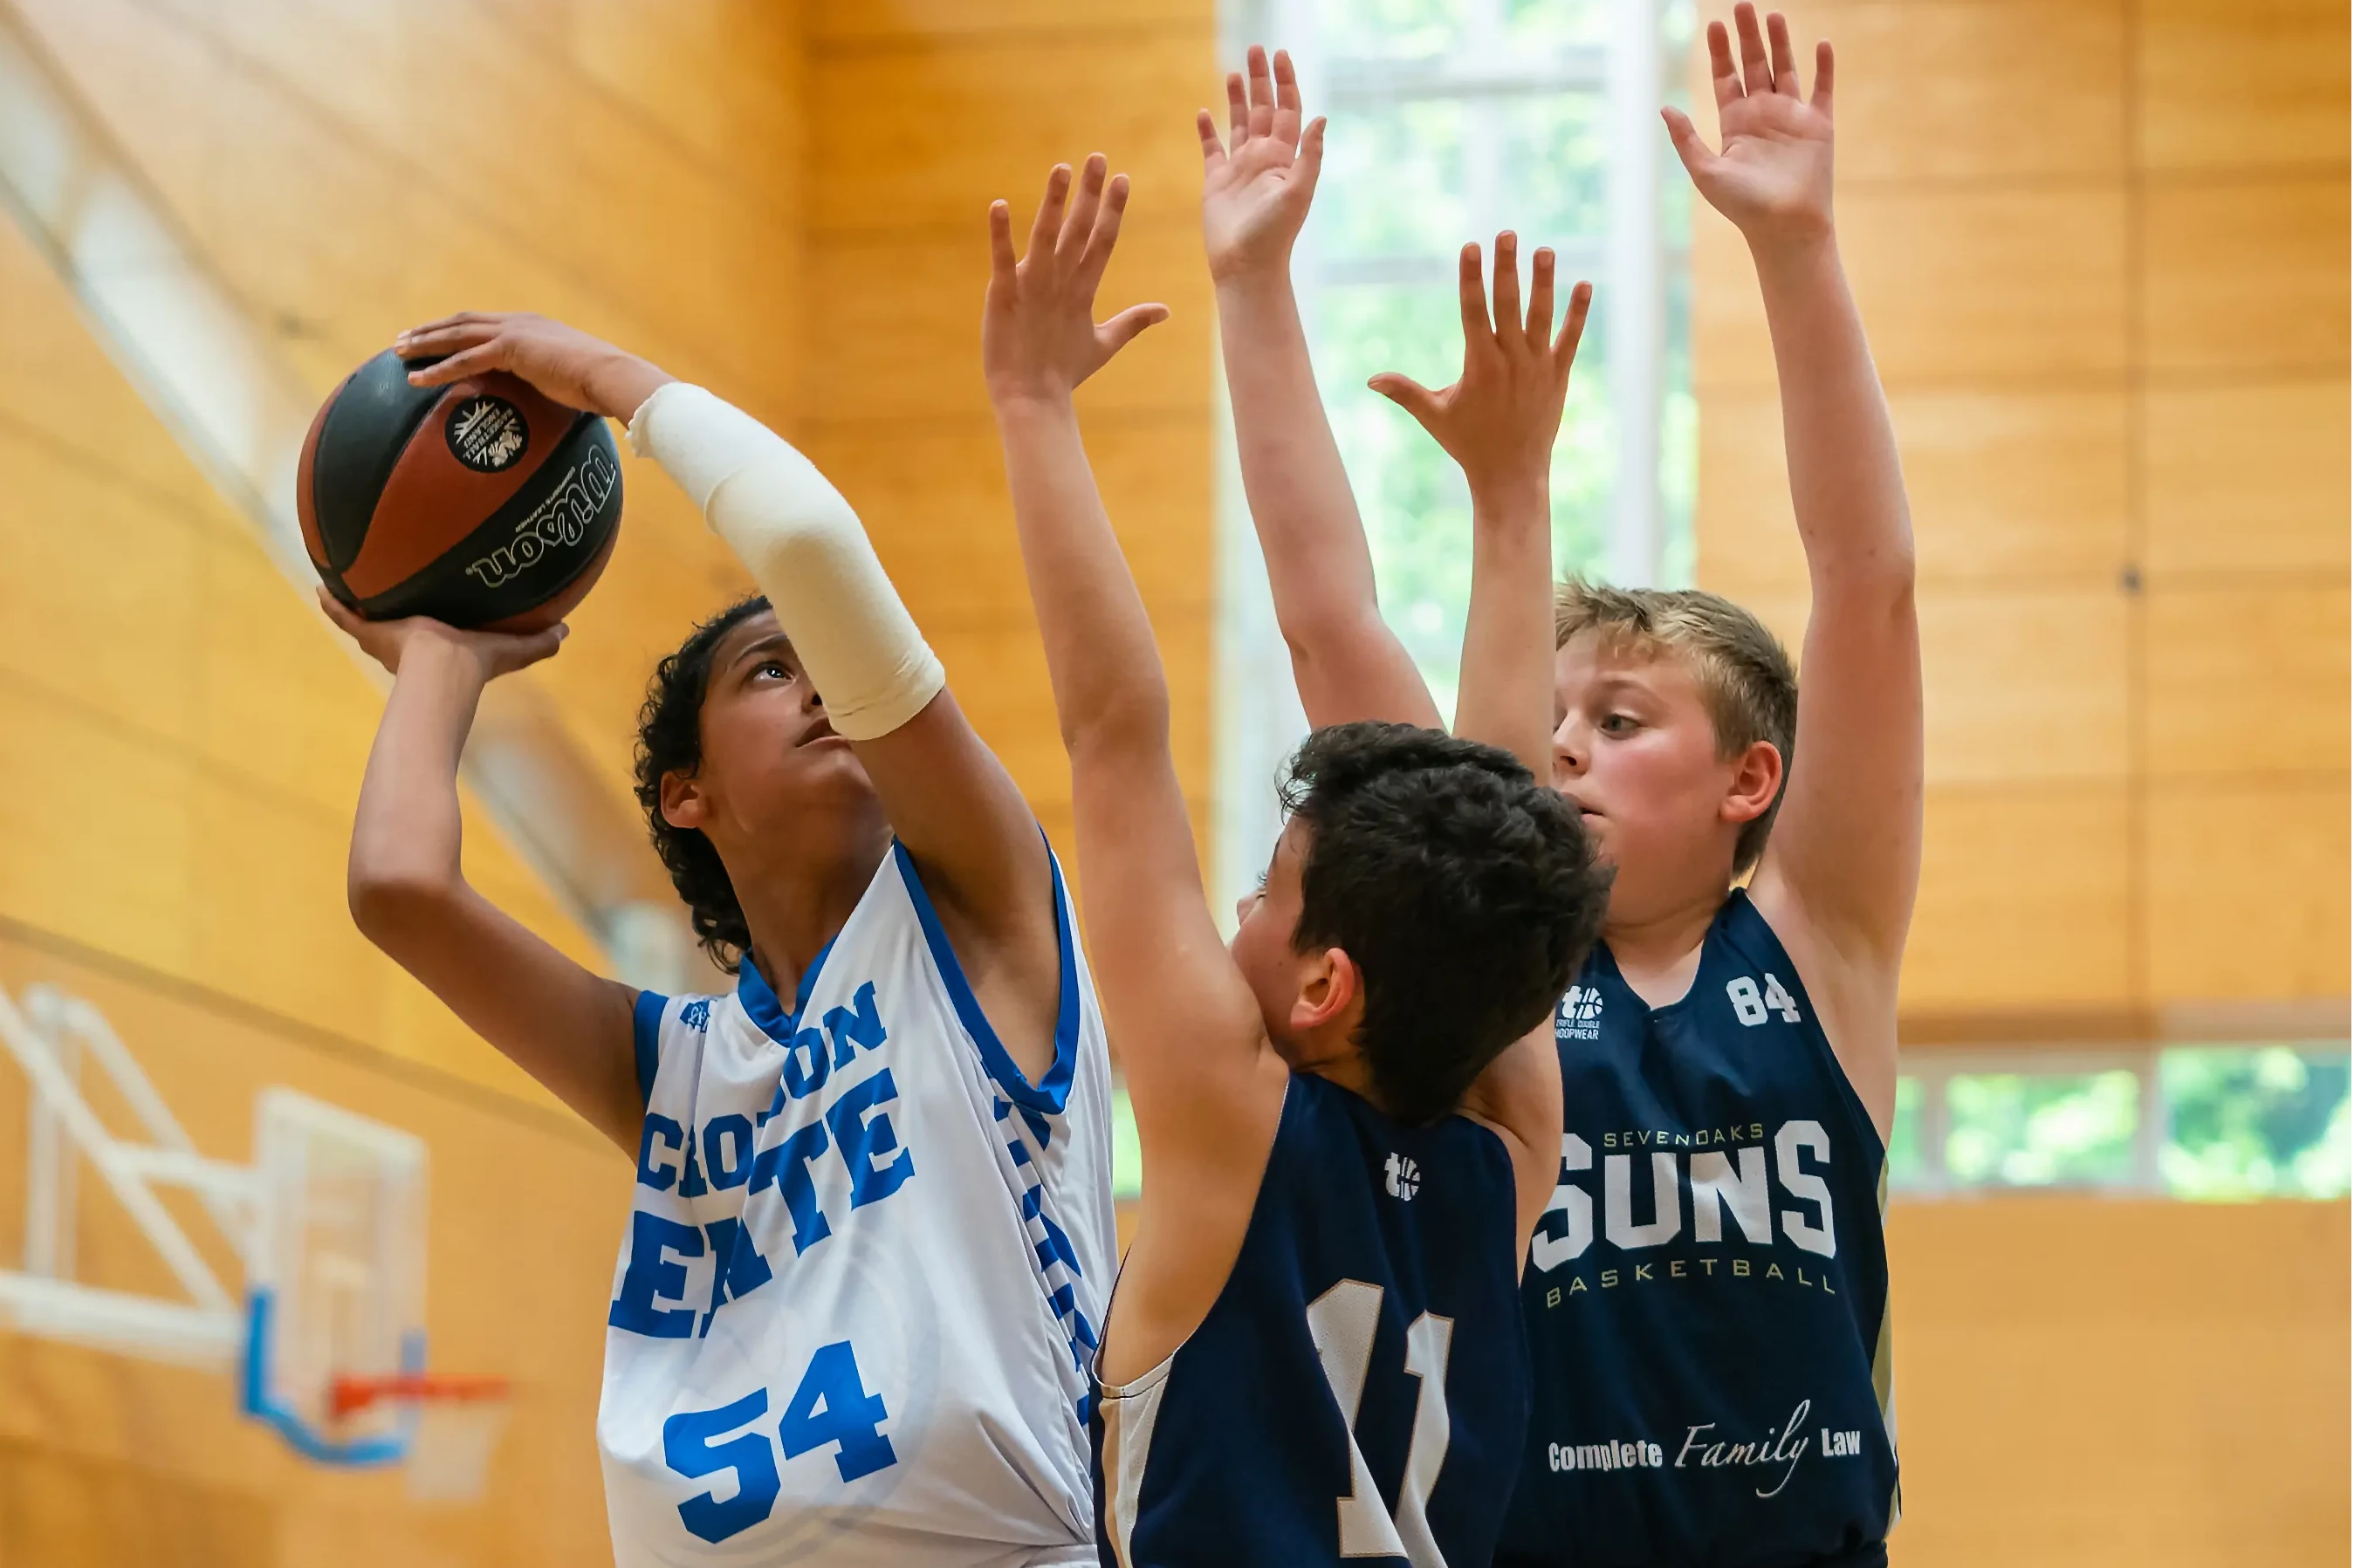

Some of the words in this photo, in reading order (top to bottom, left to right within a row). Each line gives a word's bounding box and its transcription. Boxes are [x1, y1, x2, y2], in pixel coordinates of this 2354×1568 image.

[472, 444, 616, 588] Wilson
[1726, 973, 1802, 1027] 84
[1604, 1122, 1764, 1148] SEVENOAKS
[1532, 1120, 1836, 1273] SUNS
[1547, 1258, 1836, 1309] BASKETBALL
[662, 1339, 898, 1544] 54
[1548, 1439, 1663, 1472] Complete
[1674, 1399, 1811, 1498] Family
[1820, 1428, 1861, 1457] Law
